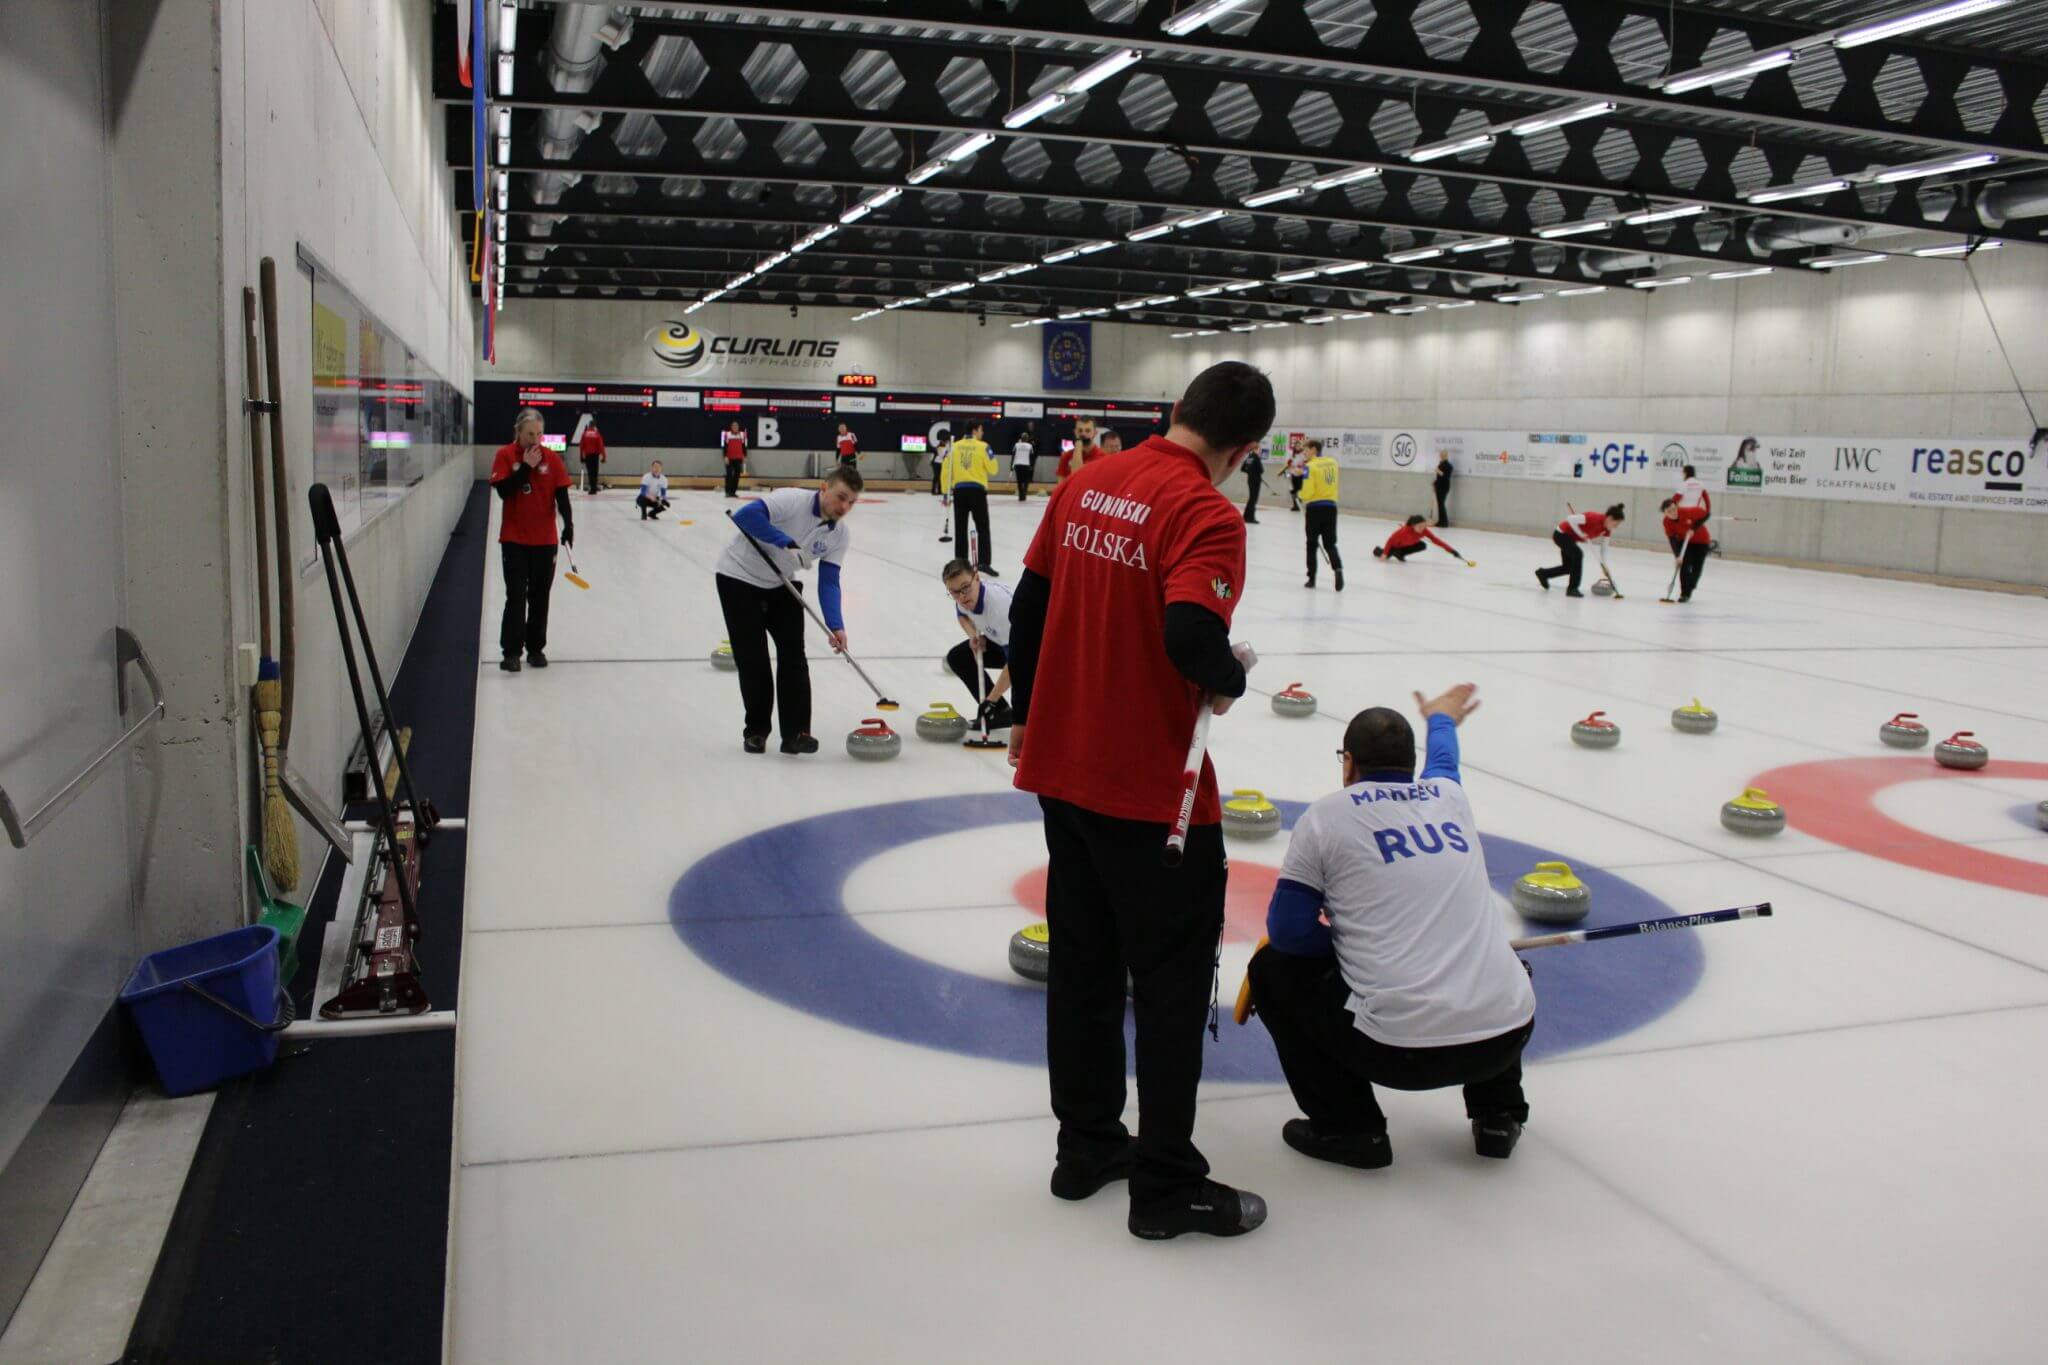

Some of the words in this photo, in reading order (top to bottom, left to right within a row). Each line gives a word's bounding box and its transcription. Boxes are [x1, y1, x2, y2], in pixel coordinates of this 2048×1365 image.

[710, 337, 839, 358] CURLING
[758, 416, 781, 447] B
[1394, 441, 1412, 458] SIG
[1770, 447, 1786, 458] Viel
[1789, 448, 1806, 459] Zeit
[1787, 461, 1801, 472] ein
[1834, 447, 1882, 473] IWC
[1911, 448, 2025, 477] reasco
[1729, 471, 1761, 483] Falken
[1764, 474, 1787, 486] gutes
[1789, 474, 1807, 485] Bier
[1816, 479, 1896, 491] SCHAFFHAUSEN
[1928, 492, 1953, 501] ESTATE
[1062, 522, 1149, 571] POLSKA
[1373, 822, 1469, 864] RUS
[1638, 914, 1717, 935] BalancePlus
